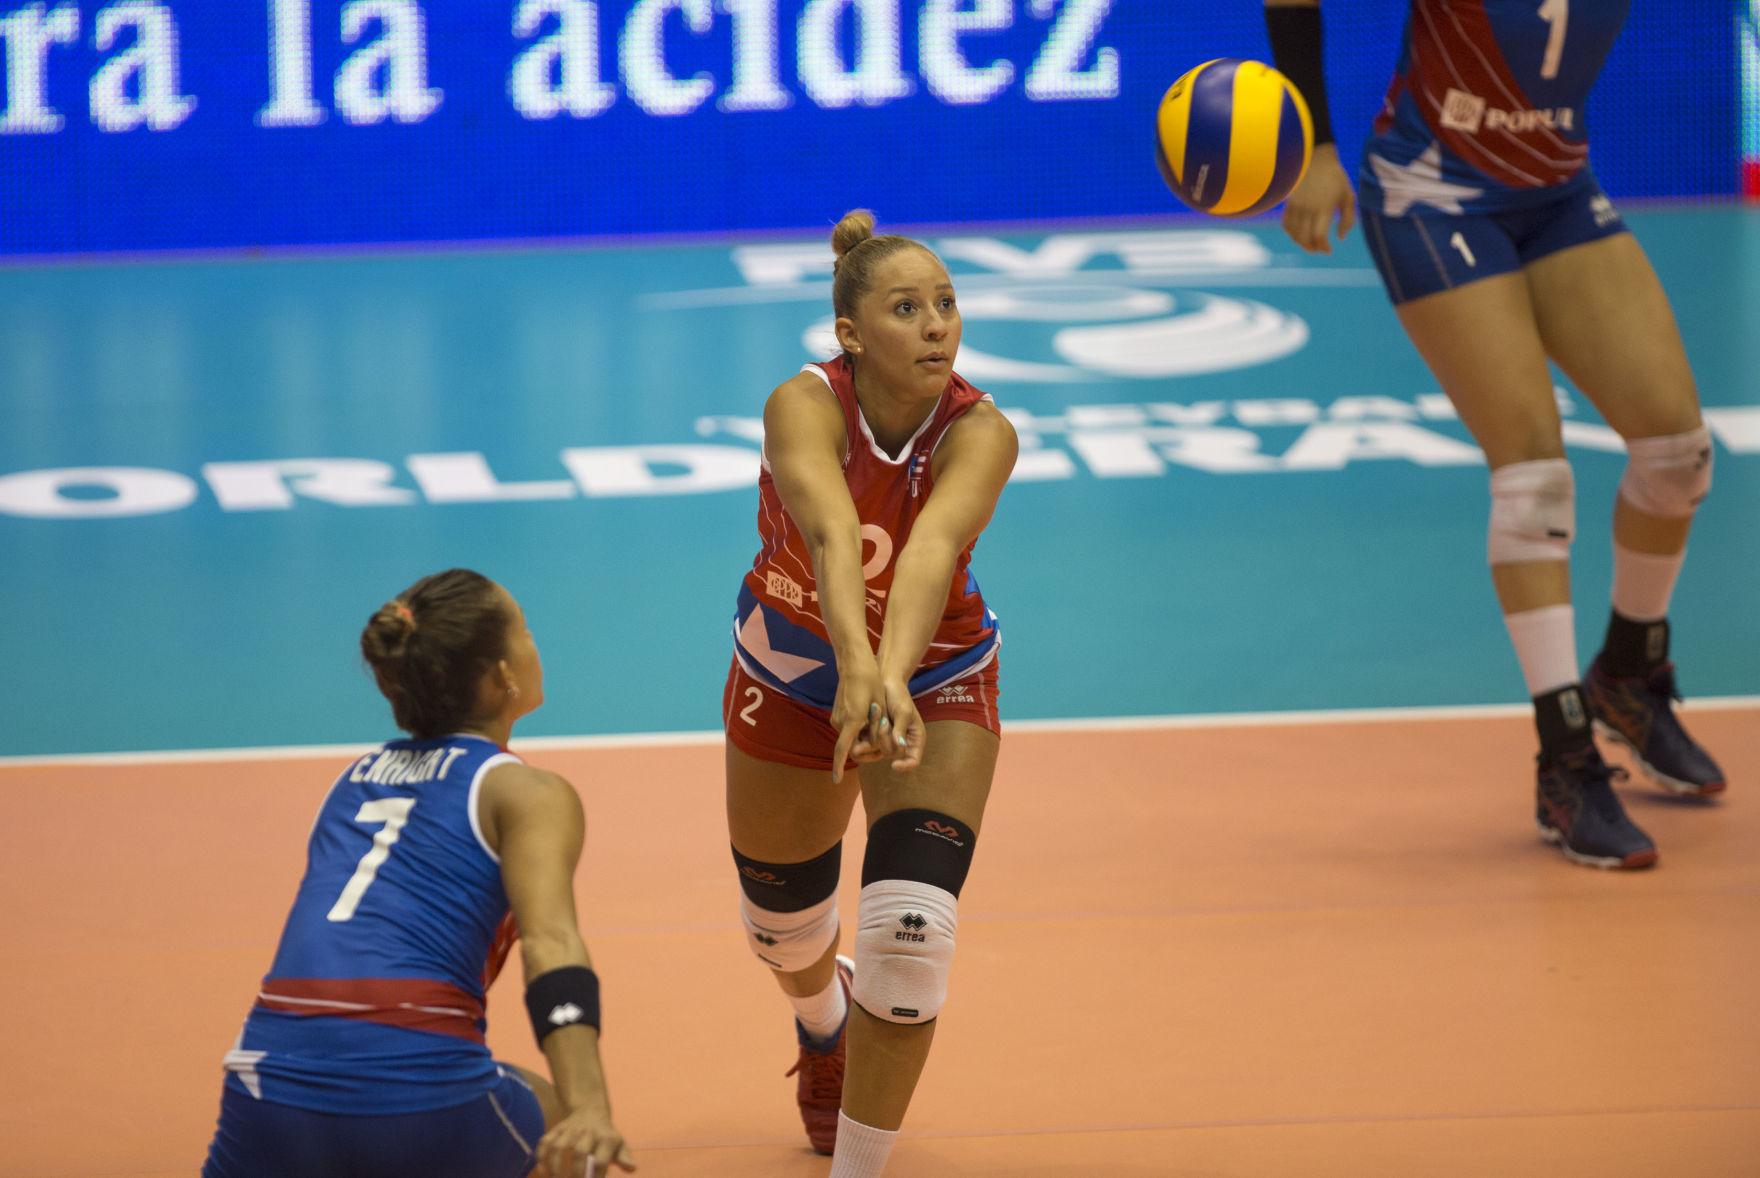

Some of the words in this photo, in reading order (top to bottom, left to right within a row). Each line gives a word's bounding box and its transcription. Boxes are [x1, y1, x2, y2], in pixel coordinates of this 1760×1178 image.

[0, 2, 198, 134] ra
[252, 0, 444, 128] la
[507, 0, 1119, 119] acidez
[1538, 0, 1569, 79] 1
[1450, 232, 1476, 267] 1
[0, 444, 763, 519] ORLD
[739, 686, 764, 727] 2
[327, 797, 416, 922] 7
[895, 931, 926, 943] errea
